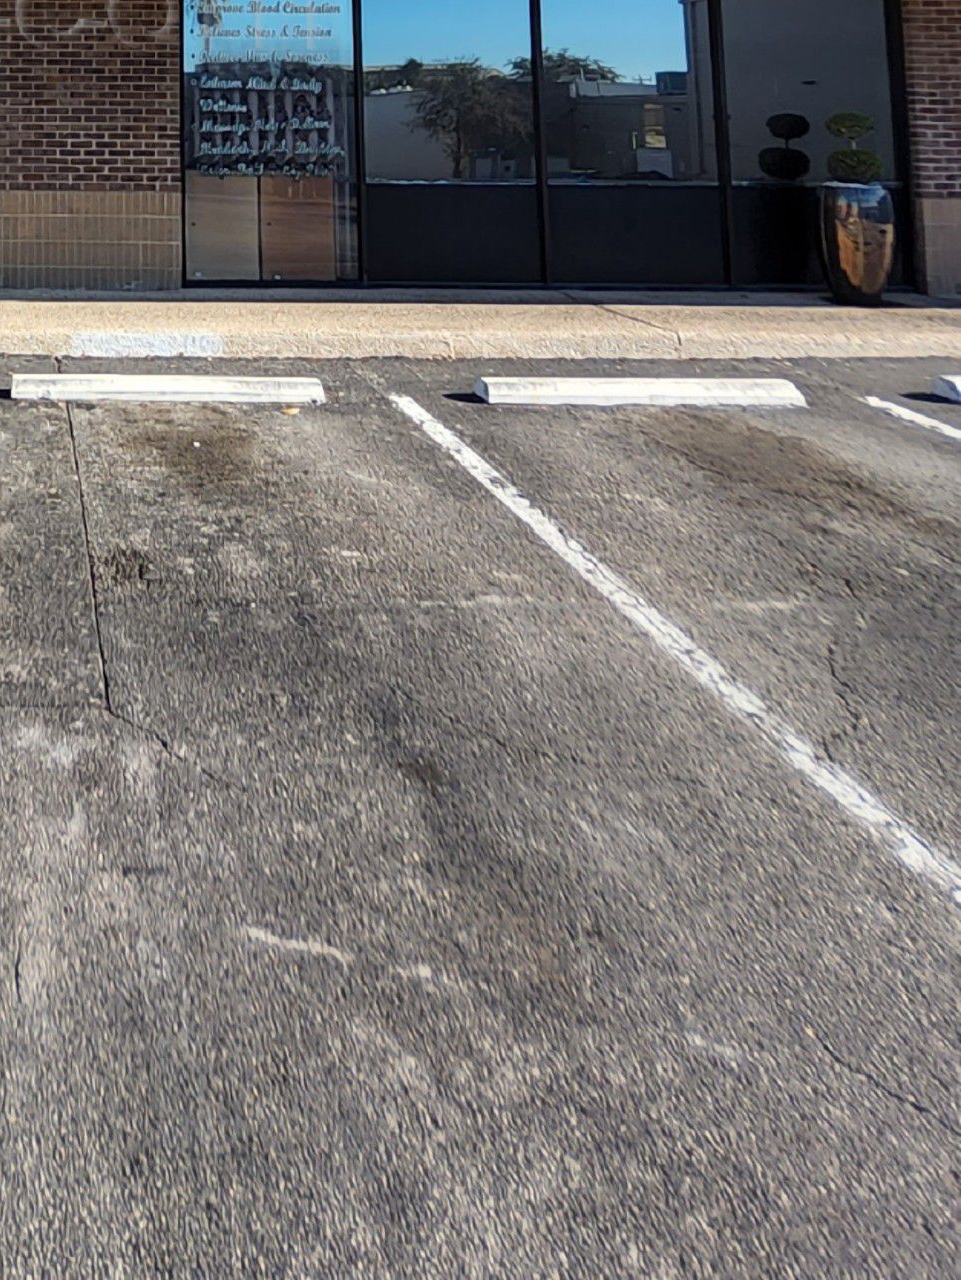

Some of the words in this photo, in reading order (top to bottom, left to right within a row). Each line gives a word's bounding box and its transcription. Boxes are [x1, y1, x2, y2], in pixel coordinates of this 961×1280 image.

[247, 1, 280, 14] Blood
[283, 1, 341, 14] Circulation
[245, 24, 277, 38] Stress
[280, 25, 290, 38] &
